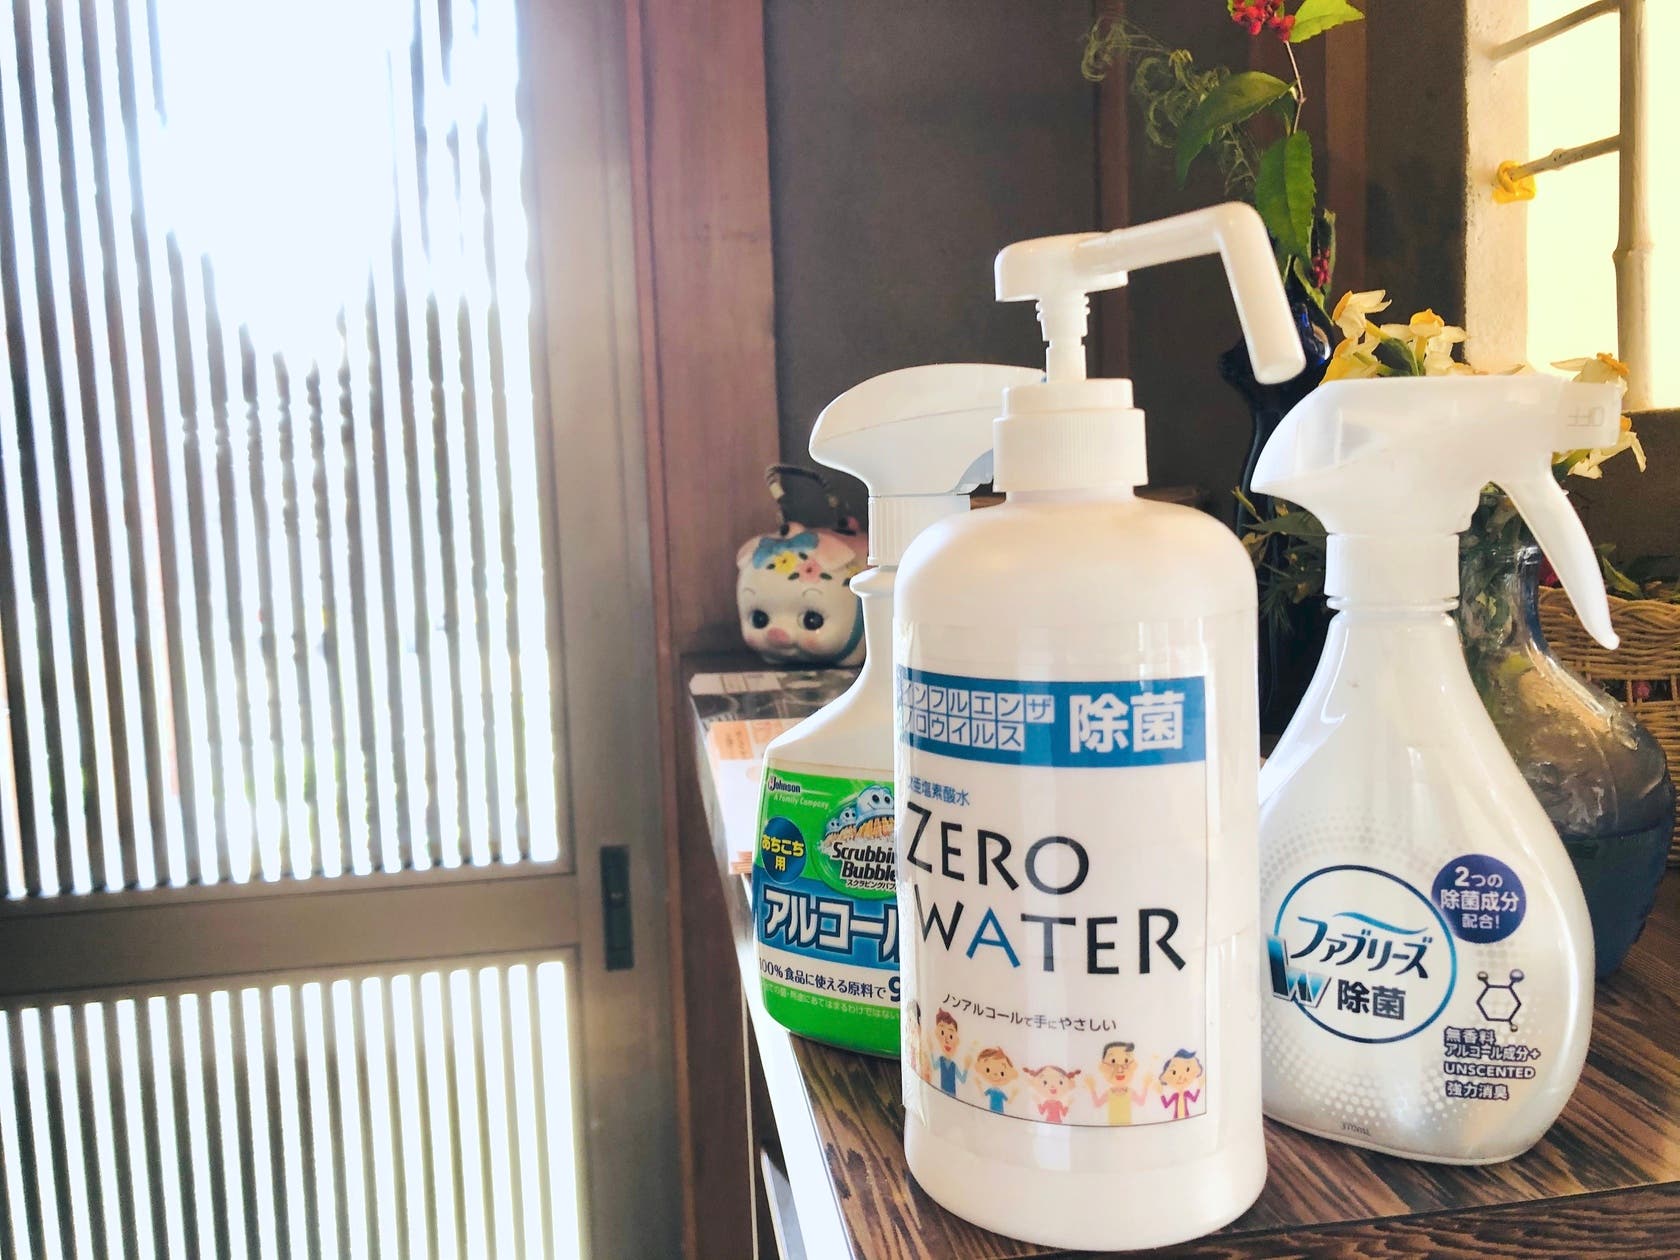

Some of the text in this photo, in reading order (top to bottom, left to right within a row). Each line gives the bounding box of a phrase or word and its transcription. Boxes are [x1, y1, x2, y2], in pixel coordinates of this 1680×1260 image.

[1068, 691, 1186, 754] 除菌
[769, 775, 801, 794] Johnson
[908, 775, 970, 807] 亜塩素酸水
[799, 796, 830, 810] Company
[761, 834, 805, 858] あちこち
[906, 801, 1090, 895] ZERO
[774, 856, 787, 872] 用
[1454, 866, 1504, 888] 2つの
[1440, 889, 1520, 912] 除菌成分
[913, 883, 1187, 975] WATER
[1289, 915, 1434, 979] ファブリーズ
[1337, 978, 1407, 1021] 除菌
[941, 993, 1118, 1032] ノンアルコールで手にやさしい
[1443, 1026, 1497, 1045] 無香料
[1444, 1061, 1536, 1079] UNSCENTED
[1445, 1080, 1510, 1101] 強力消臭
